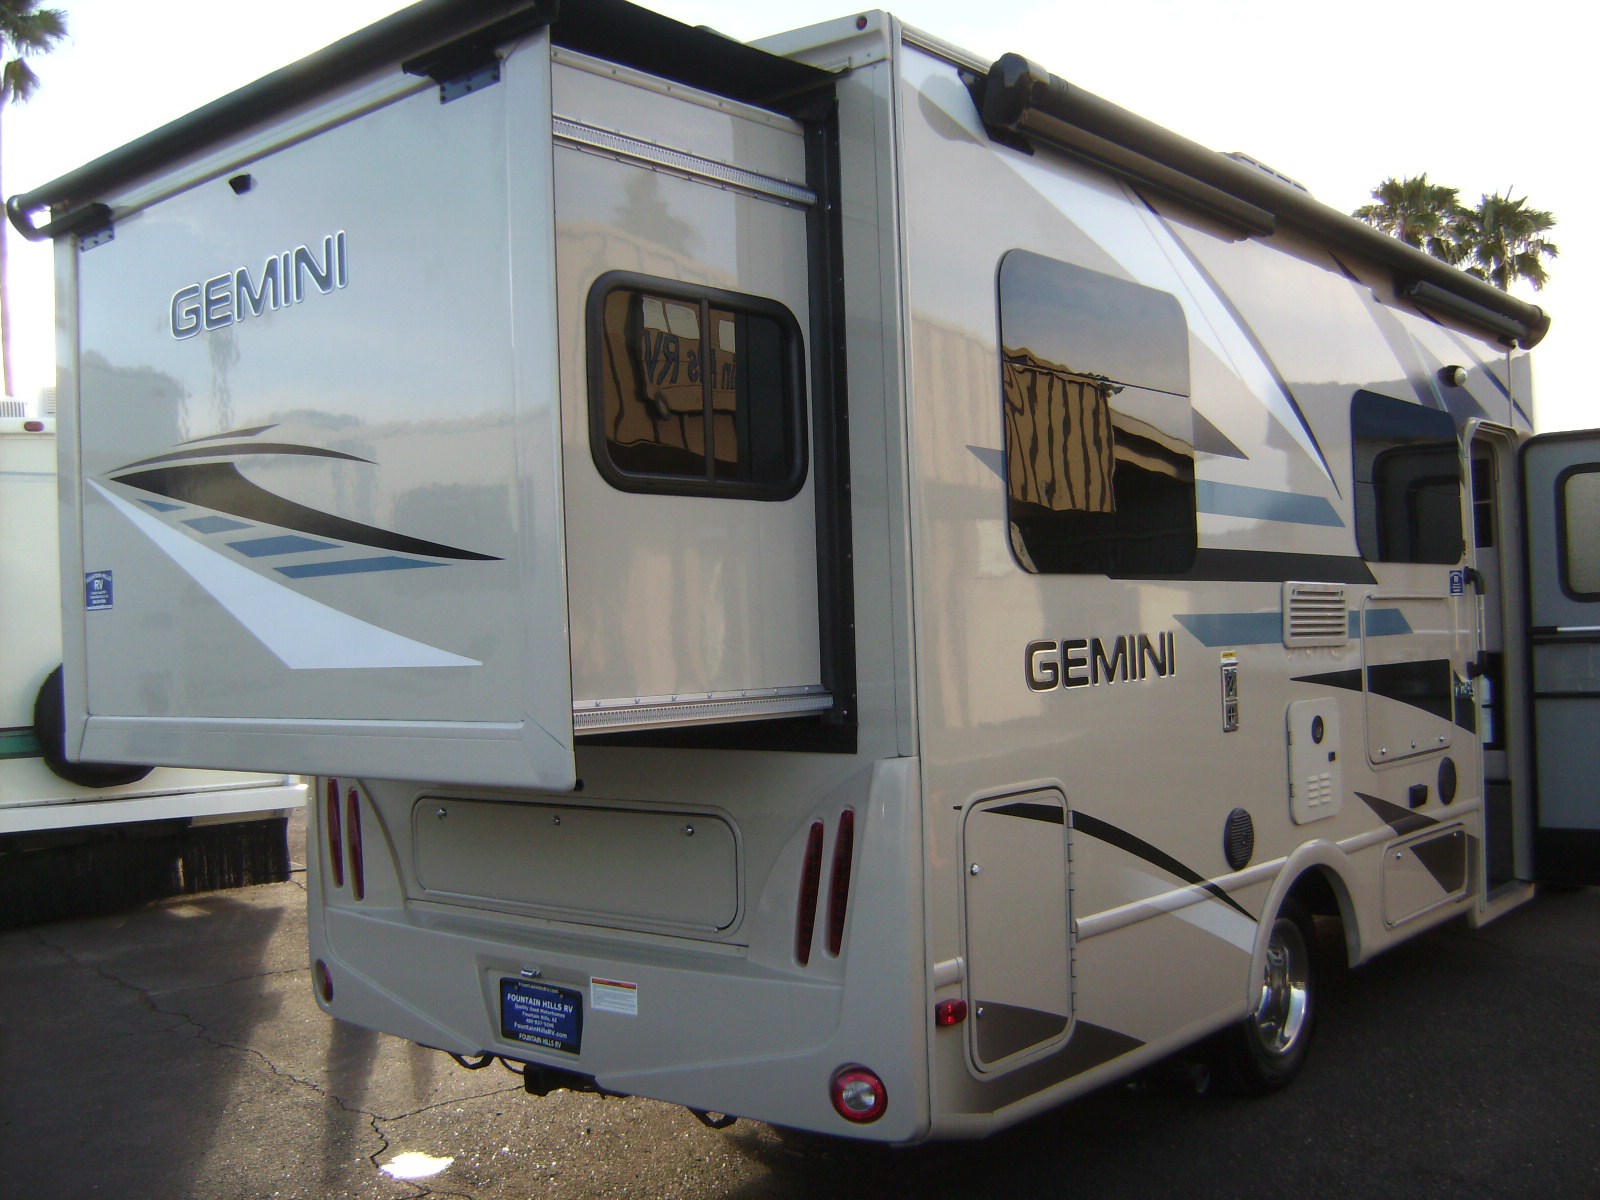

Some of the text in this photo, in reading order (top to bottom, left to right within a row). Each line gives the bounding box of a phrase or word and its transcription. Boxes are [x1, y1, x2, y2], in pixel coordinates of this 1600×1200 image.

[170, 230, 347, 341] GEMINI
[94, 579, 104, 590] RV
[1024, 631, 1176, 693] GEMINI
[507, 993, 573, 1013] FOUNTAIN HILLS RV
[519, 1033, 541, 1044] FOUNTAIN
[542, 1038, 554, 1046] HILLS
